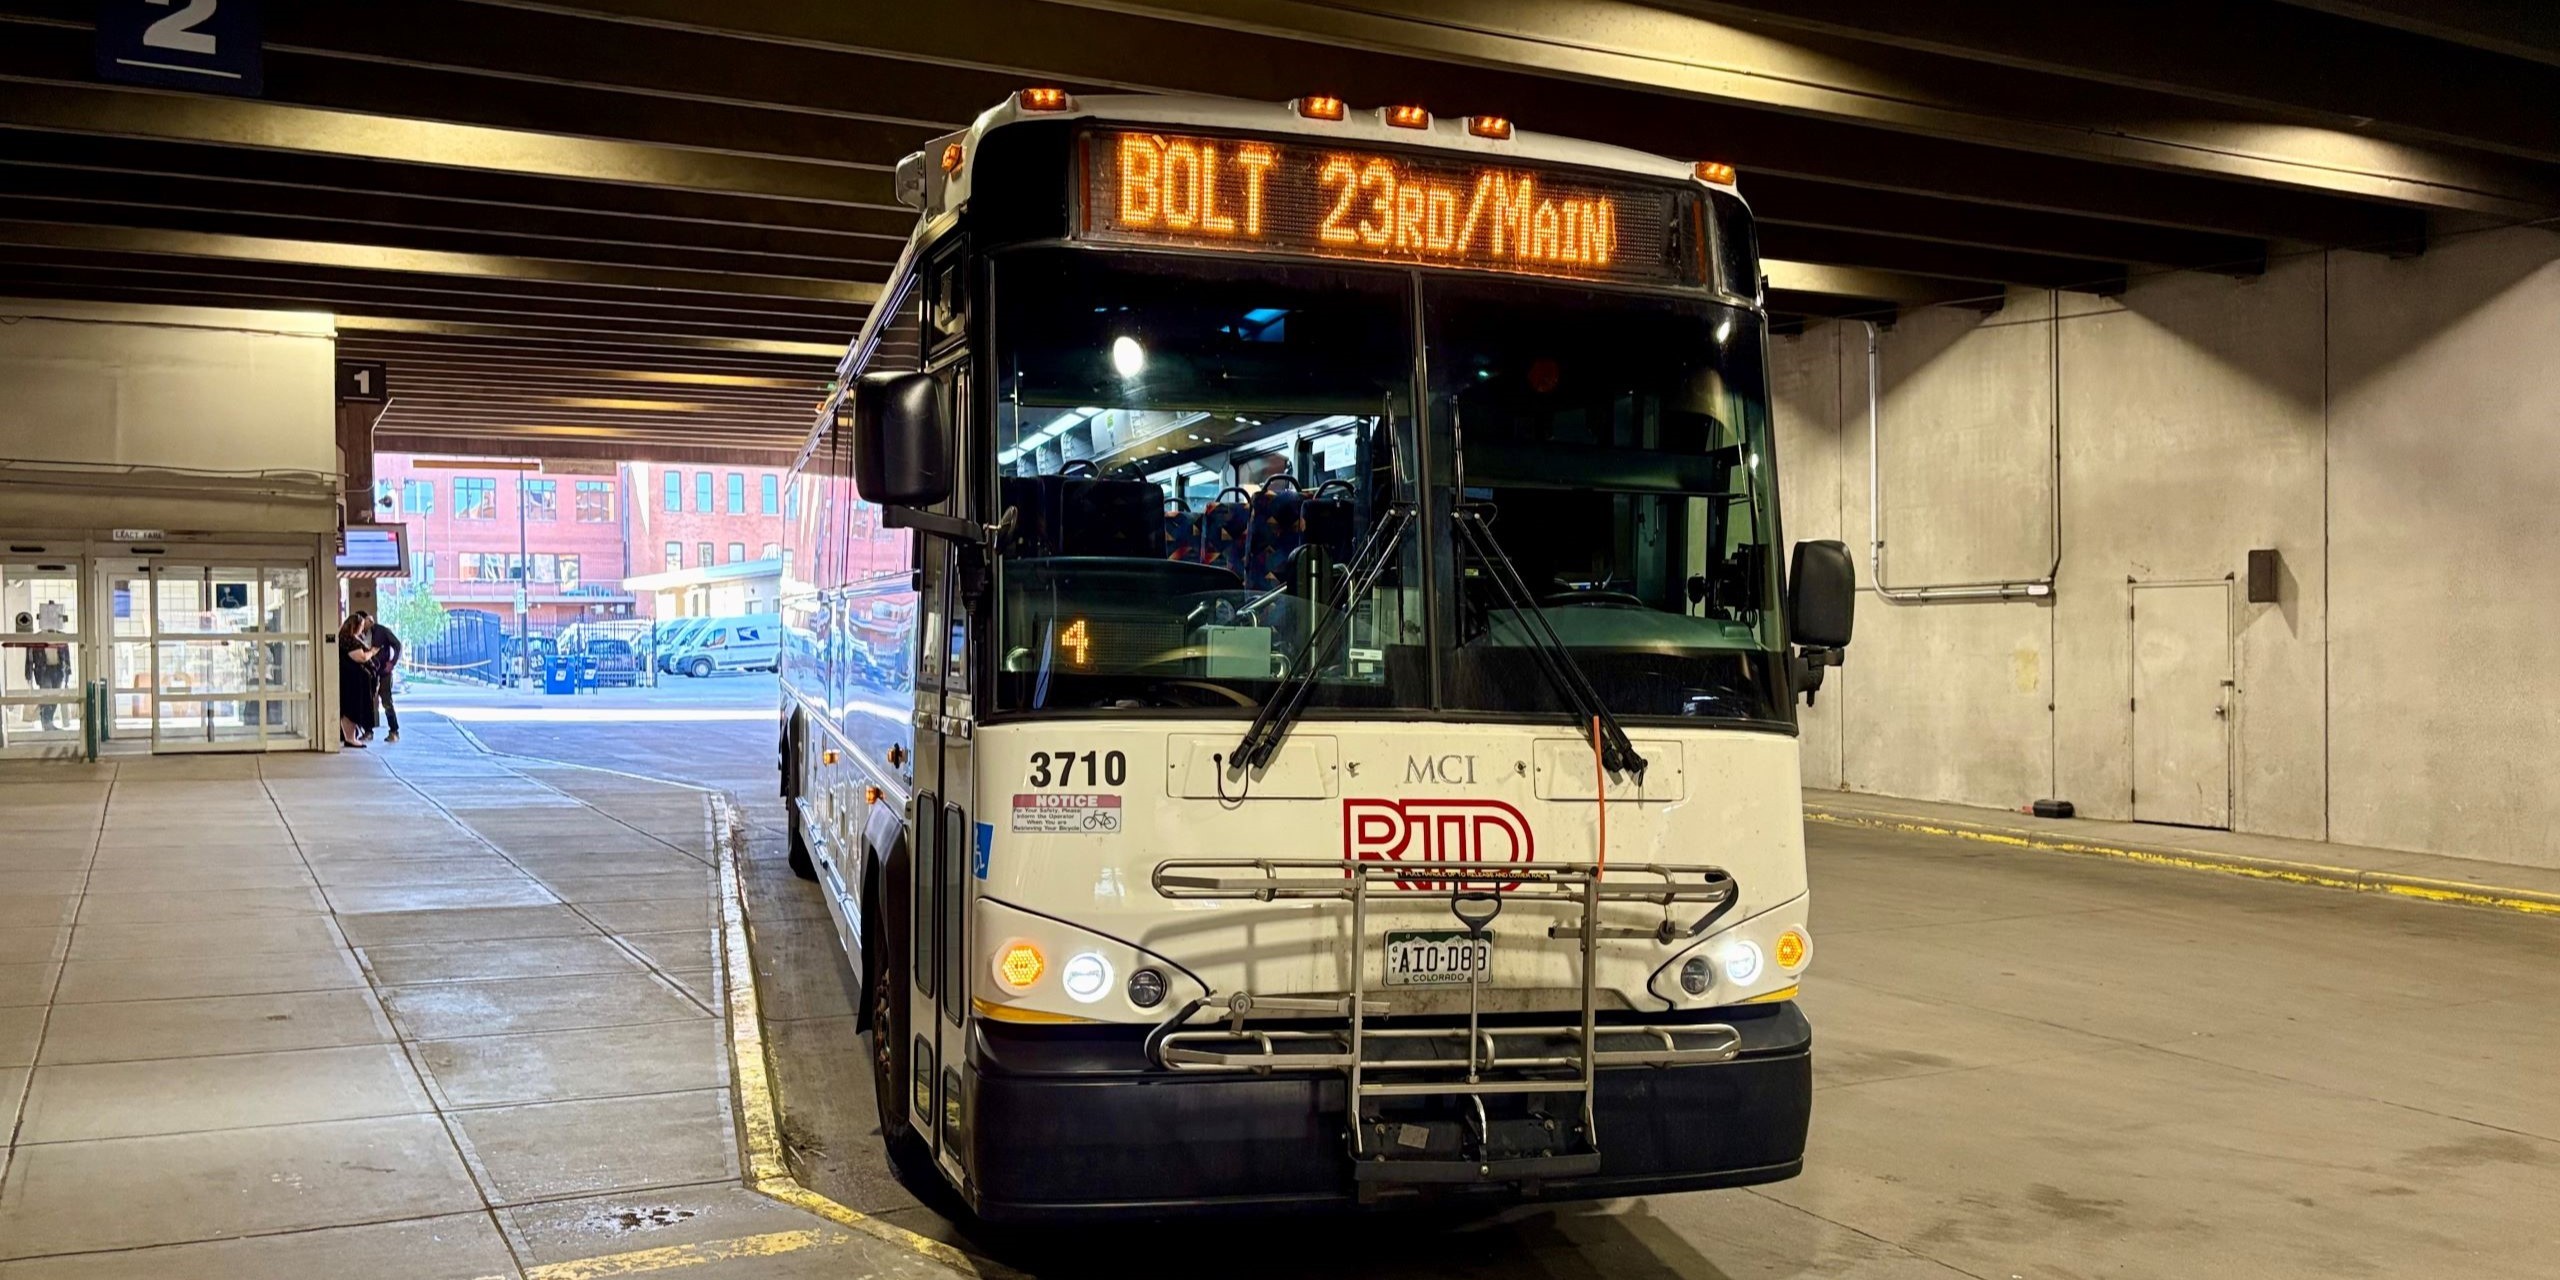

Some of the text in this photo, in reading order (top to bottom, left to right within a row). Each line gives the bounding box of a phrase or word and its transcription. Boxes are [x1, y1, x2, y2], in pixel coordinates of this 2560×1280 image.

[143, 0, 217, 55] 2
[1121, 137, 1273, 235] BOLT
[354, 370, 370, 394] 1
[1061, 620, 1089, 664] 4
[1030, 750, 1126, 787] 3710
[1403, 754, 1478, 784] MCI
[1036, 795, 1098, 807] NOTICE
[1343, 798, 1534, 892] RTD
[1412, 973, 1465, 982] COLORADO
